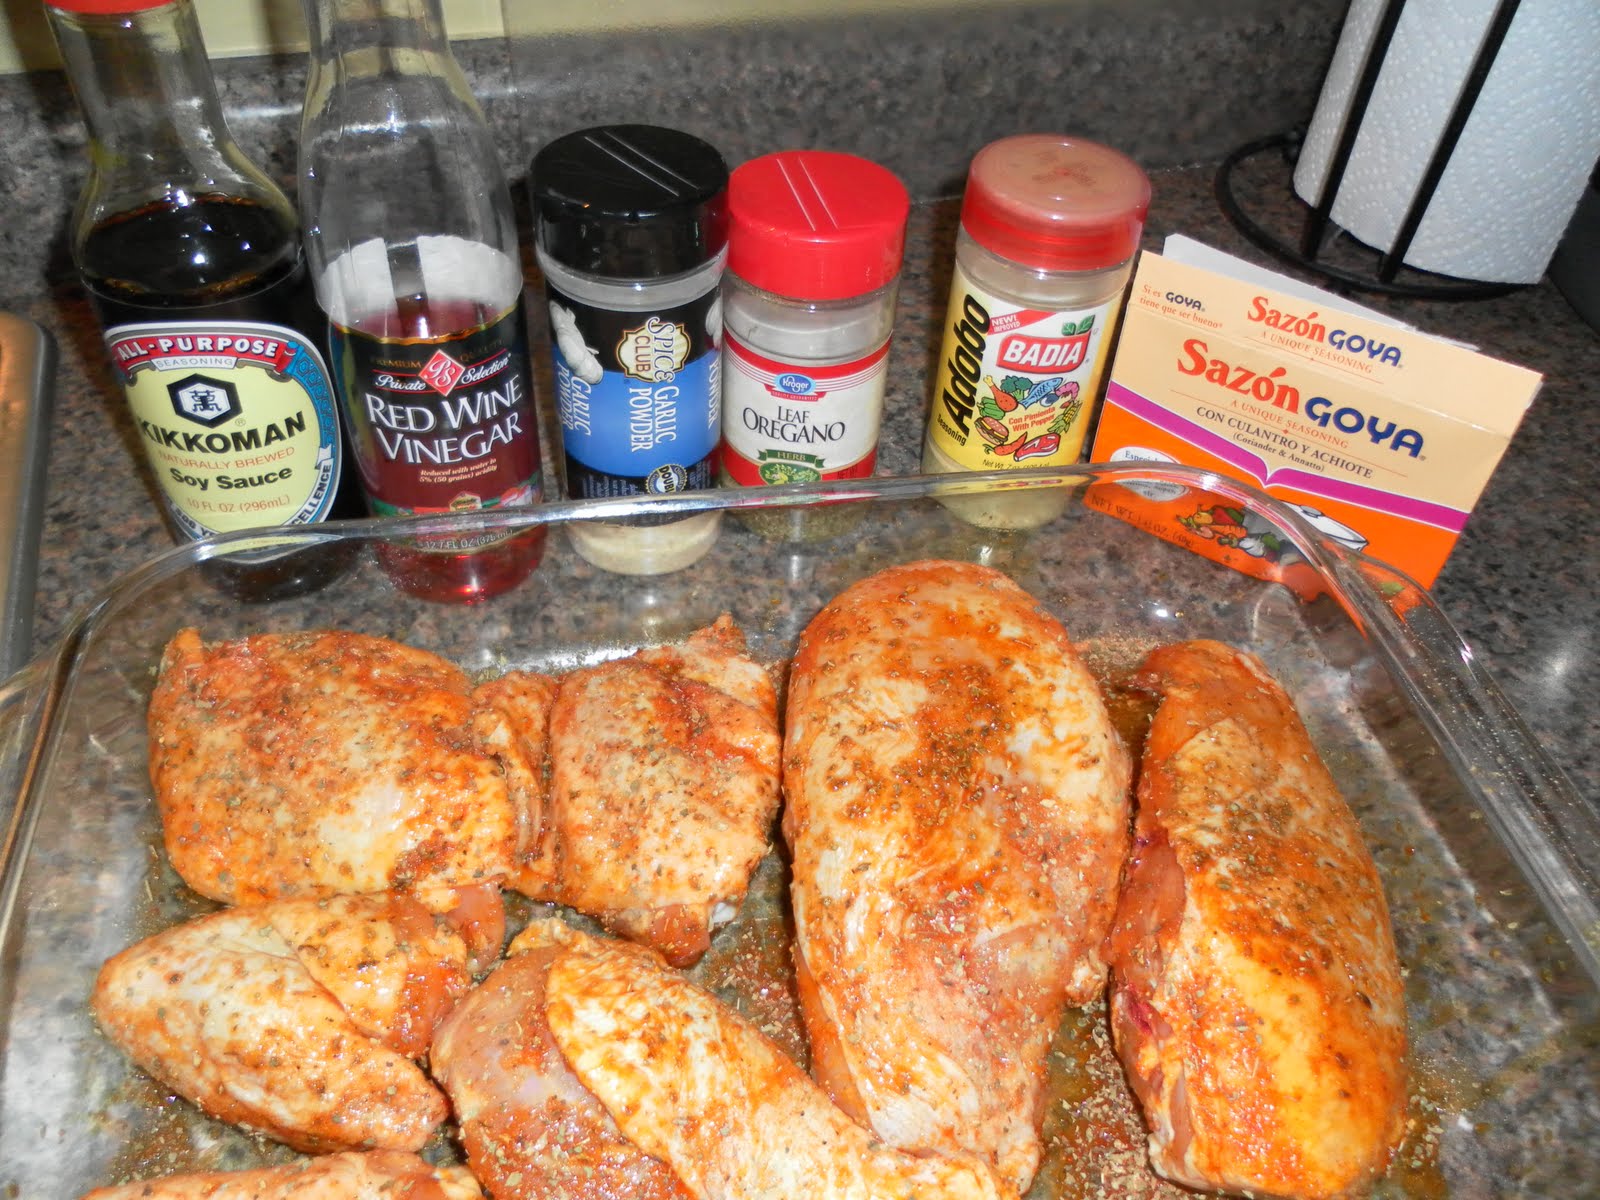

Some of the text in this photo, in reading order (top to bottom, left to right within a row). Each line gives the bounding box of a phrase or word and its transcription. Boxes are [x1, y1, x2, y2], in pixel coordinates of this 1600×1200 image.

[1140, 296, 1219, 328] tiene que ser bueno
[1143, 284, 1202, 311] Si es GOYA
[991, 314, 1018, 328] NEW!
[993, 321, 1021, 333] IMPROVED
[1247, 296, 1402, 367] Sazón GOYA
[117, 337, 279, 361] ALL-PURPOSE
[156, 357, 234, 369] SEASONING
[634, 335, 651, 373] CLUB
[647, 316, 676, 383] SPICE
[942, 294, 991, 438] Adobo
[1003, 339, 1083, 367] BADIA
[1270, 333, 1311, 353] UNIQUE
[1313, 347, 1373, 374] SEASONING
[375, 355, 510, 391] Private Selection
[783, 376, 809, 393] Kroger
[365, 375, 523, 432] RED WINE
[556, 360, 574, 431] POWDER
[571, 376, 592, 437] GARLIC
[1177, 338, 1424, 459] Sazón GOYA
[141, 410, 306, 454] KIKKOMAN
[629, 387, 655, 453] POWDER
[654, 385, 680, 444] GARLIC
[742, 407, 846, 443] OREGANO
[777, 406, 810, 424] LEAF
[937, 413, 967, 446] Seasoning
[1008, 407, 1056, 425] Con Pimienta
[1012, 414, 1055, 432] With Pepper
[1230, 400, 1350, 450] A UNIQUE SEASONING
[375, 412, 523, 465] VINEGAR
[777, 451, 806, 461] HERB
[1196, 406, 1373, 479] CON CULANTRO Y ACHIOTE
[1233, 432, 1326, 473] (Coriander & Annatto)
[159, 447, 295, 469] NATURALLY BREWED
[448, 473, 474, 483] grains)
[475, 464, 498, 477] acidity
[452, 466, 469, 474] with
[470, 461, 489, 471] water
[170, 466, 292, 490] Soy Sauce
[291, 465, 331, 525] CELLENCE
[188, 498, 200, 509] 10
[219, 503, 235, 513] OZ
[240, 494, 291, 513] (296mL)
